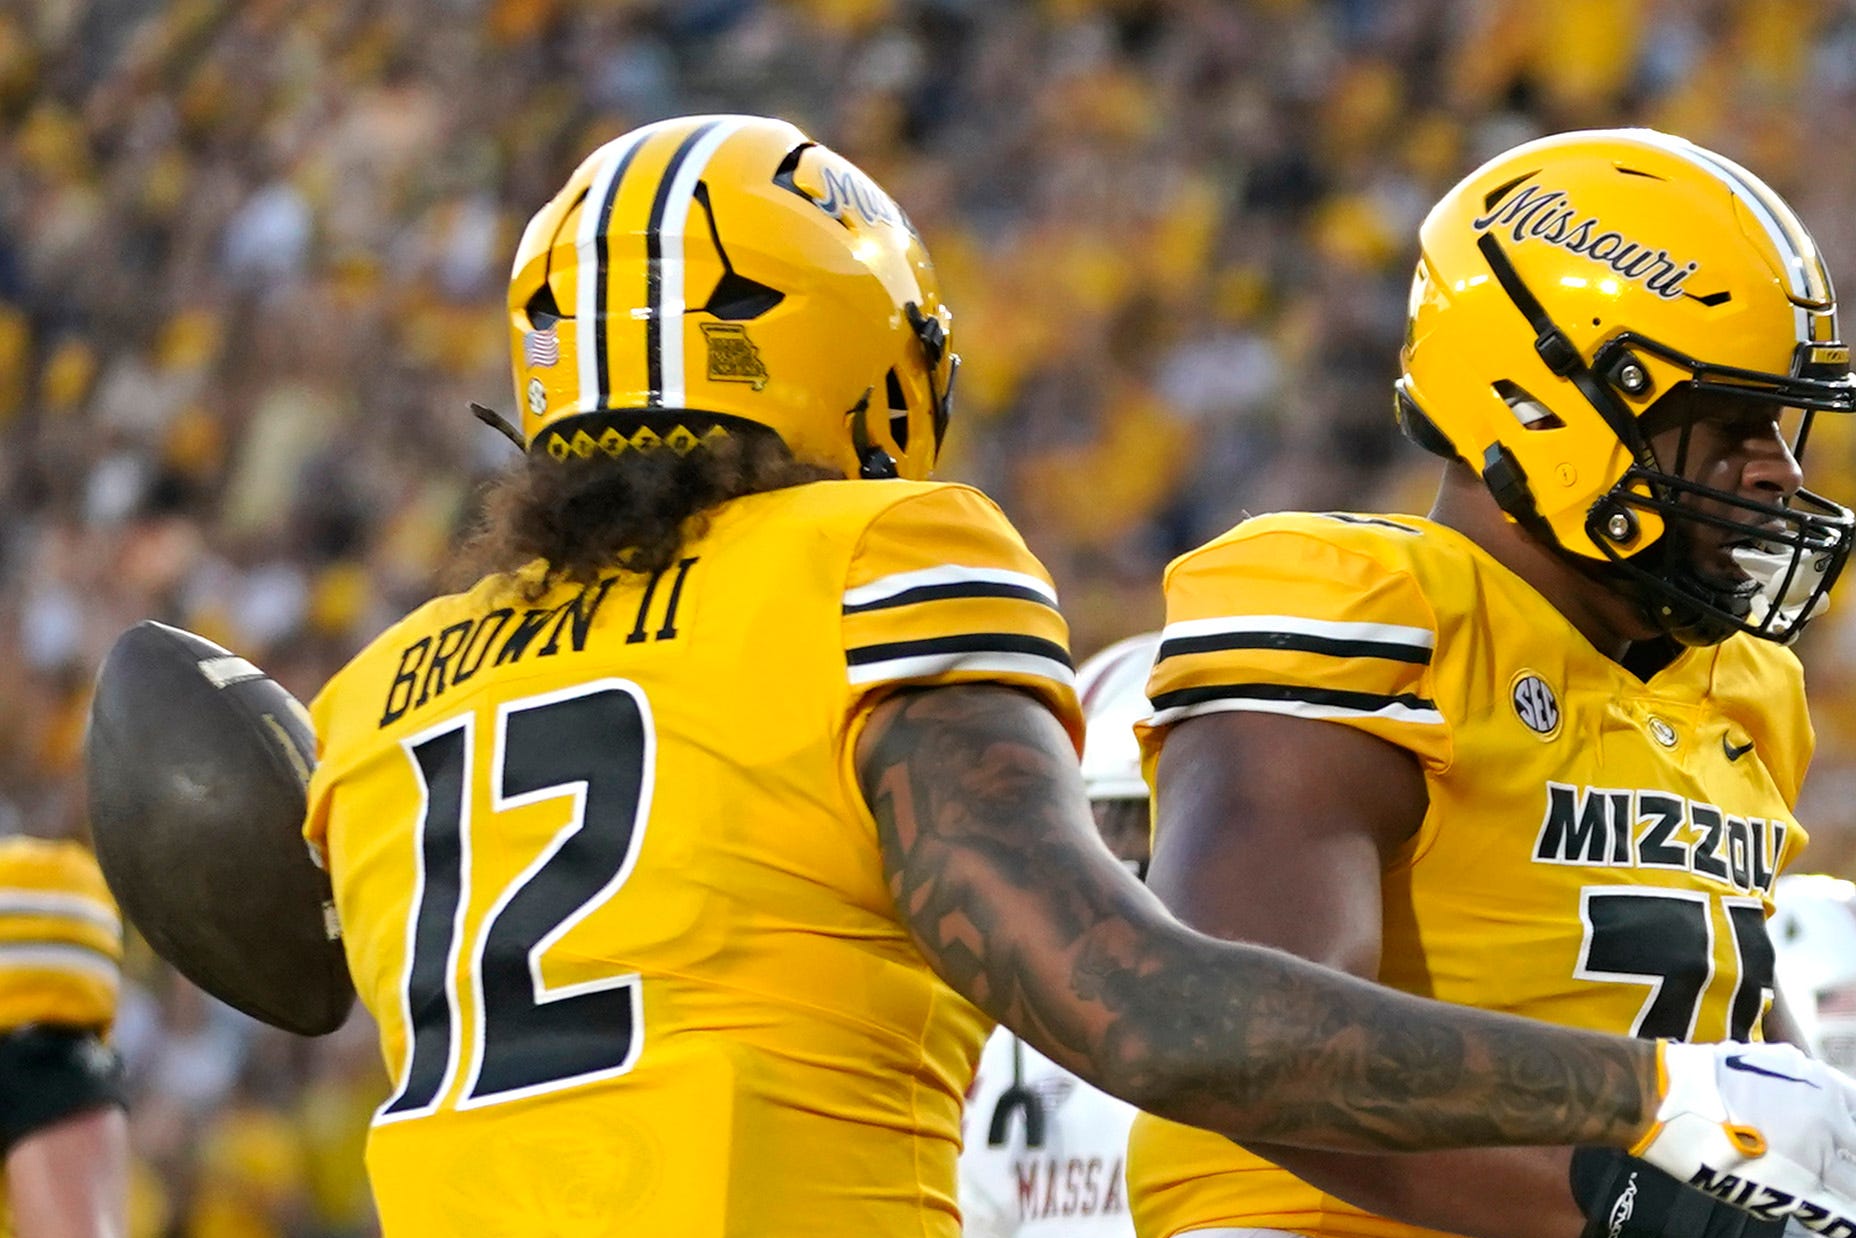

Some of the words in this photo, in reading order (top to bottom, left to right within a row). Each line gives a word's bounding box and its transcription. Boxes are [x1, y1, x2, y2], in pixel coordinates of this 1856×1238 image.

[1474, 186, 1701, 299] Missouri
[378, 574, 620, 729] BROWN
[626, 556, 700, 644] II
[1514, 675, 1559, 734] SEC
[1531, 781, 1787, 896] MIZZOU
[376, 676, 655, 1127] 12
[1013, 1157, 1125, 1221] MASSA
